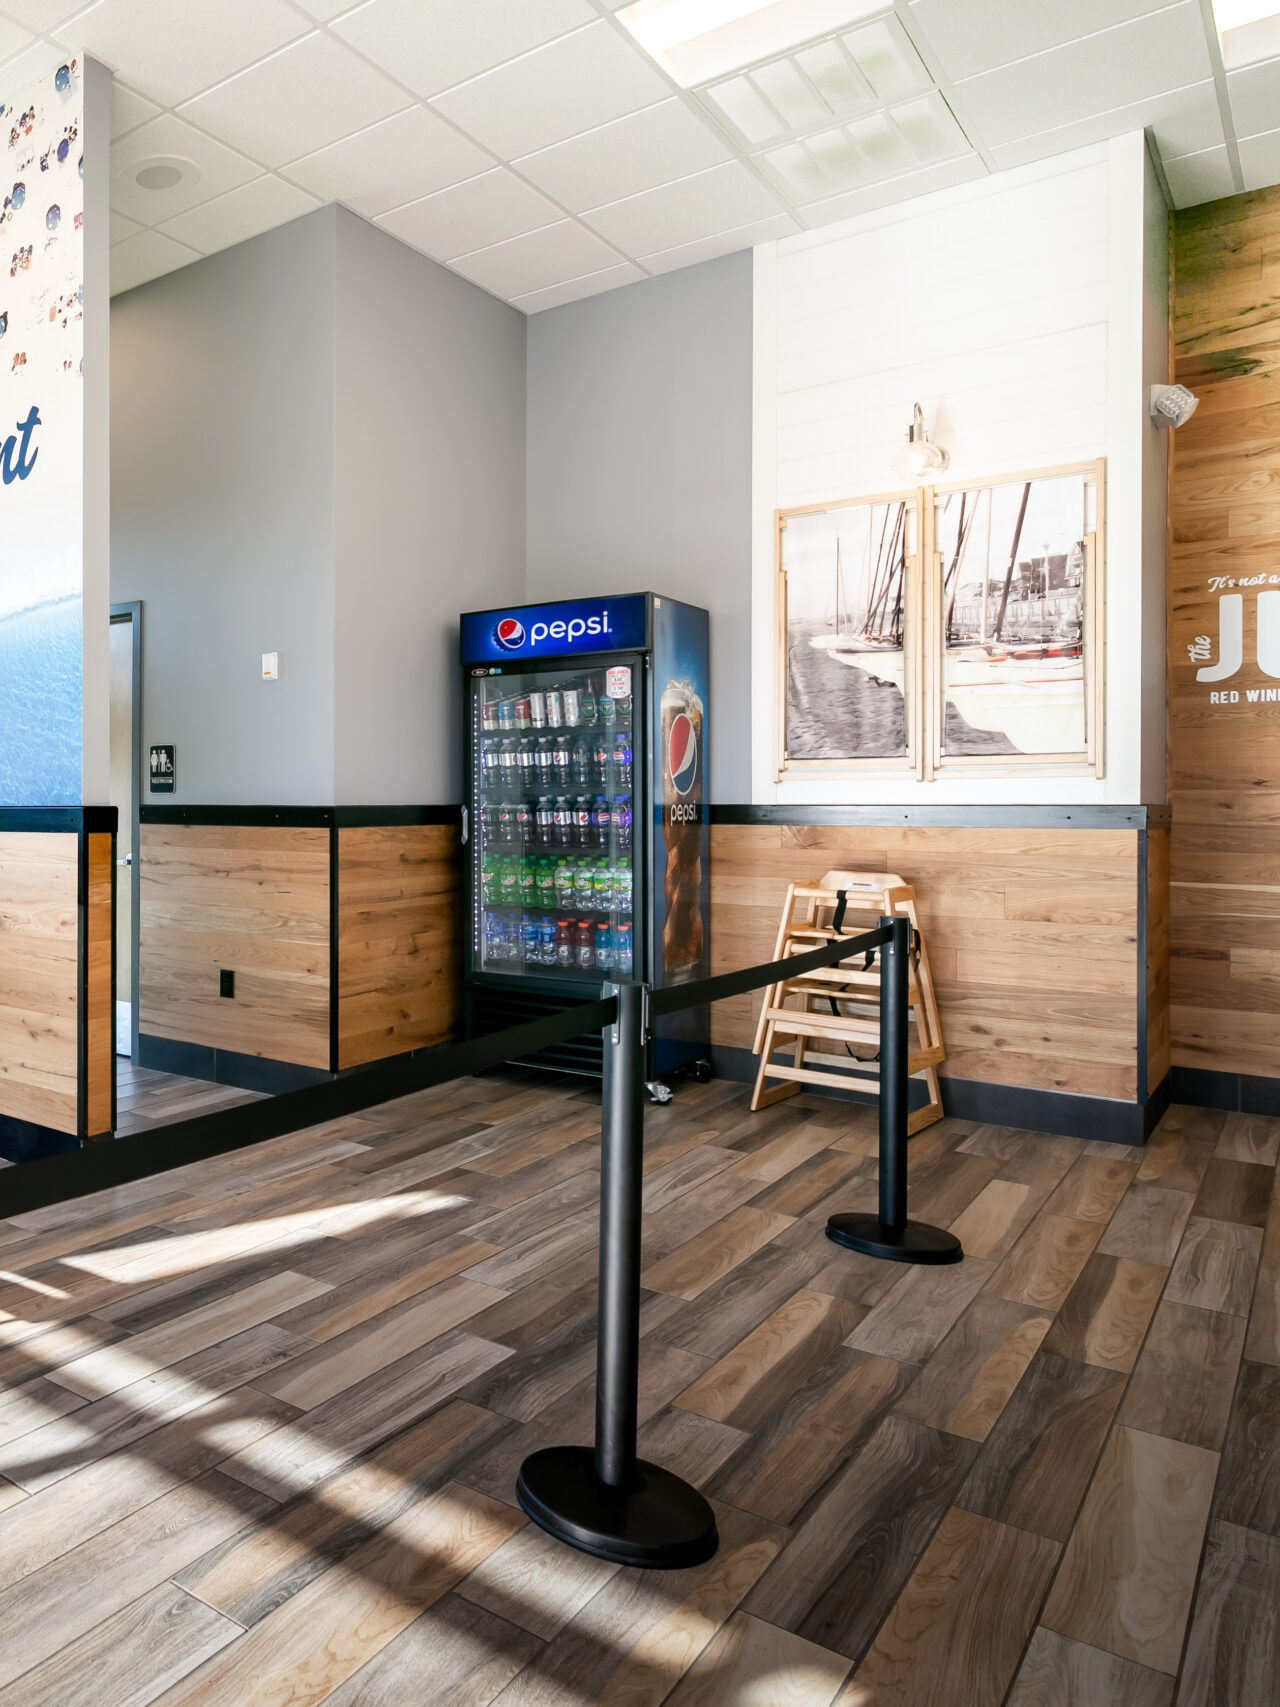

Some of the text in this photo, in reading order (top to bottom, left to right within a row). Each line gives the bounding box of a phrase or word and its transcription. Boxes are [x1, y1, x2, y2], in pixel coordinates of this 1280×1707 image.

[1208, 574, 1236, 592] It's
[1238, 572, 1267, 587] not
[531, 611, 610, 646] pepsi
[1187, 635, 1211, 663] the
[1210, 691, 1239, 704] RED
[670, 800, 697, 827] pepsi
